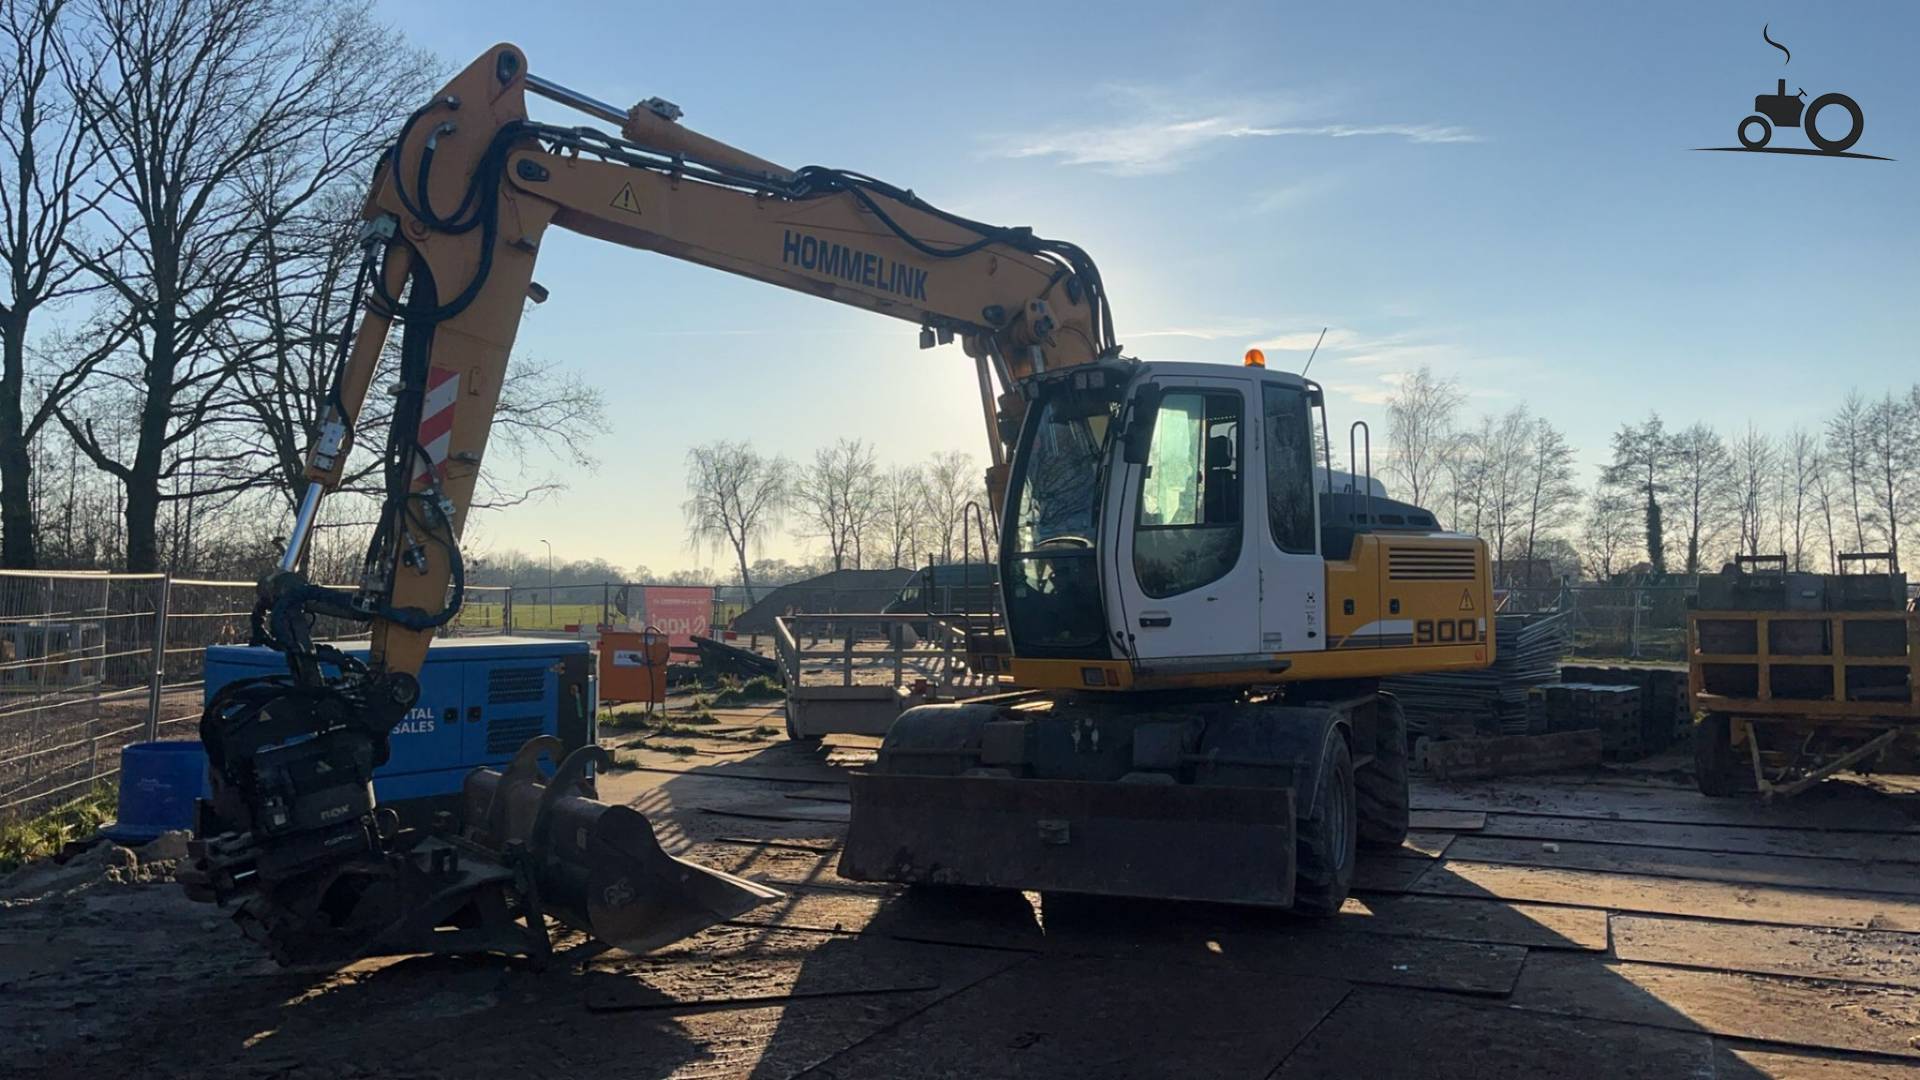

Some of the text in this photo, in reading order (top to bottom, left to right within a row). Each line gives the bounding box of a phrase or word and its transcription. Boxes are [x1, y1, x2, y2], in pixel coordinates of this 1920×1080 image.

[783, 229, 928, 301] HOMMELINK
[1417, 620, 1476, 643] 900
[392, 720, 435, 734] SALES
